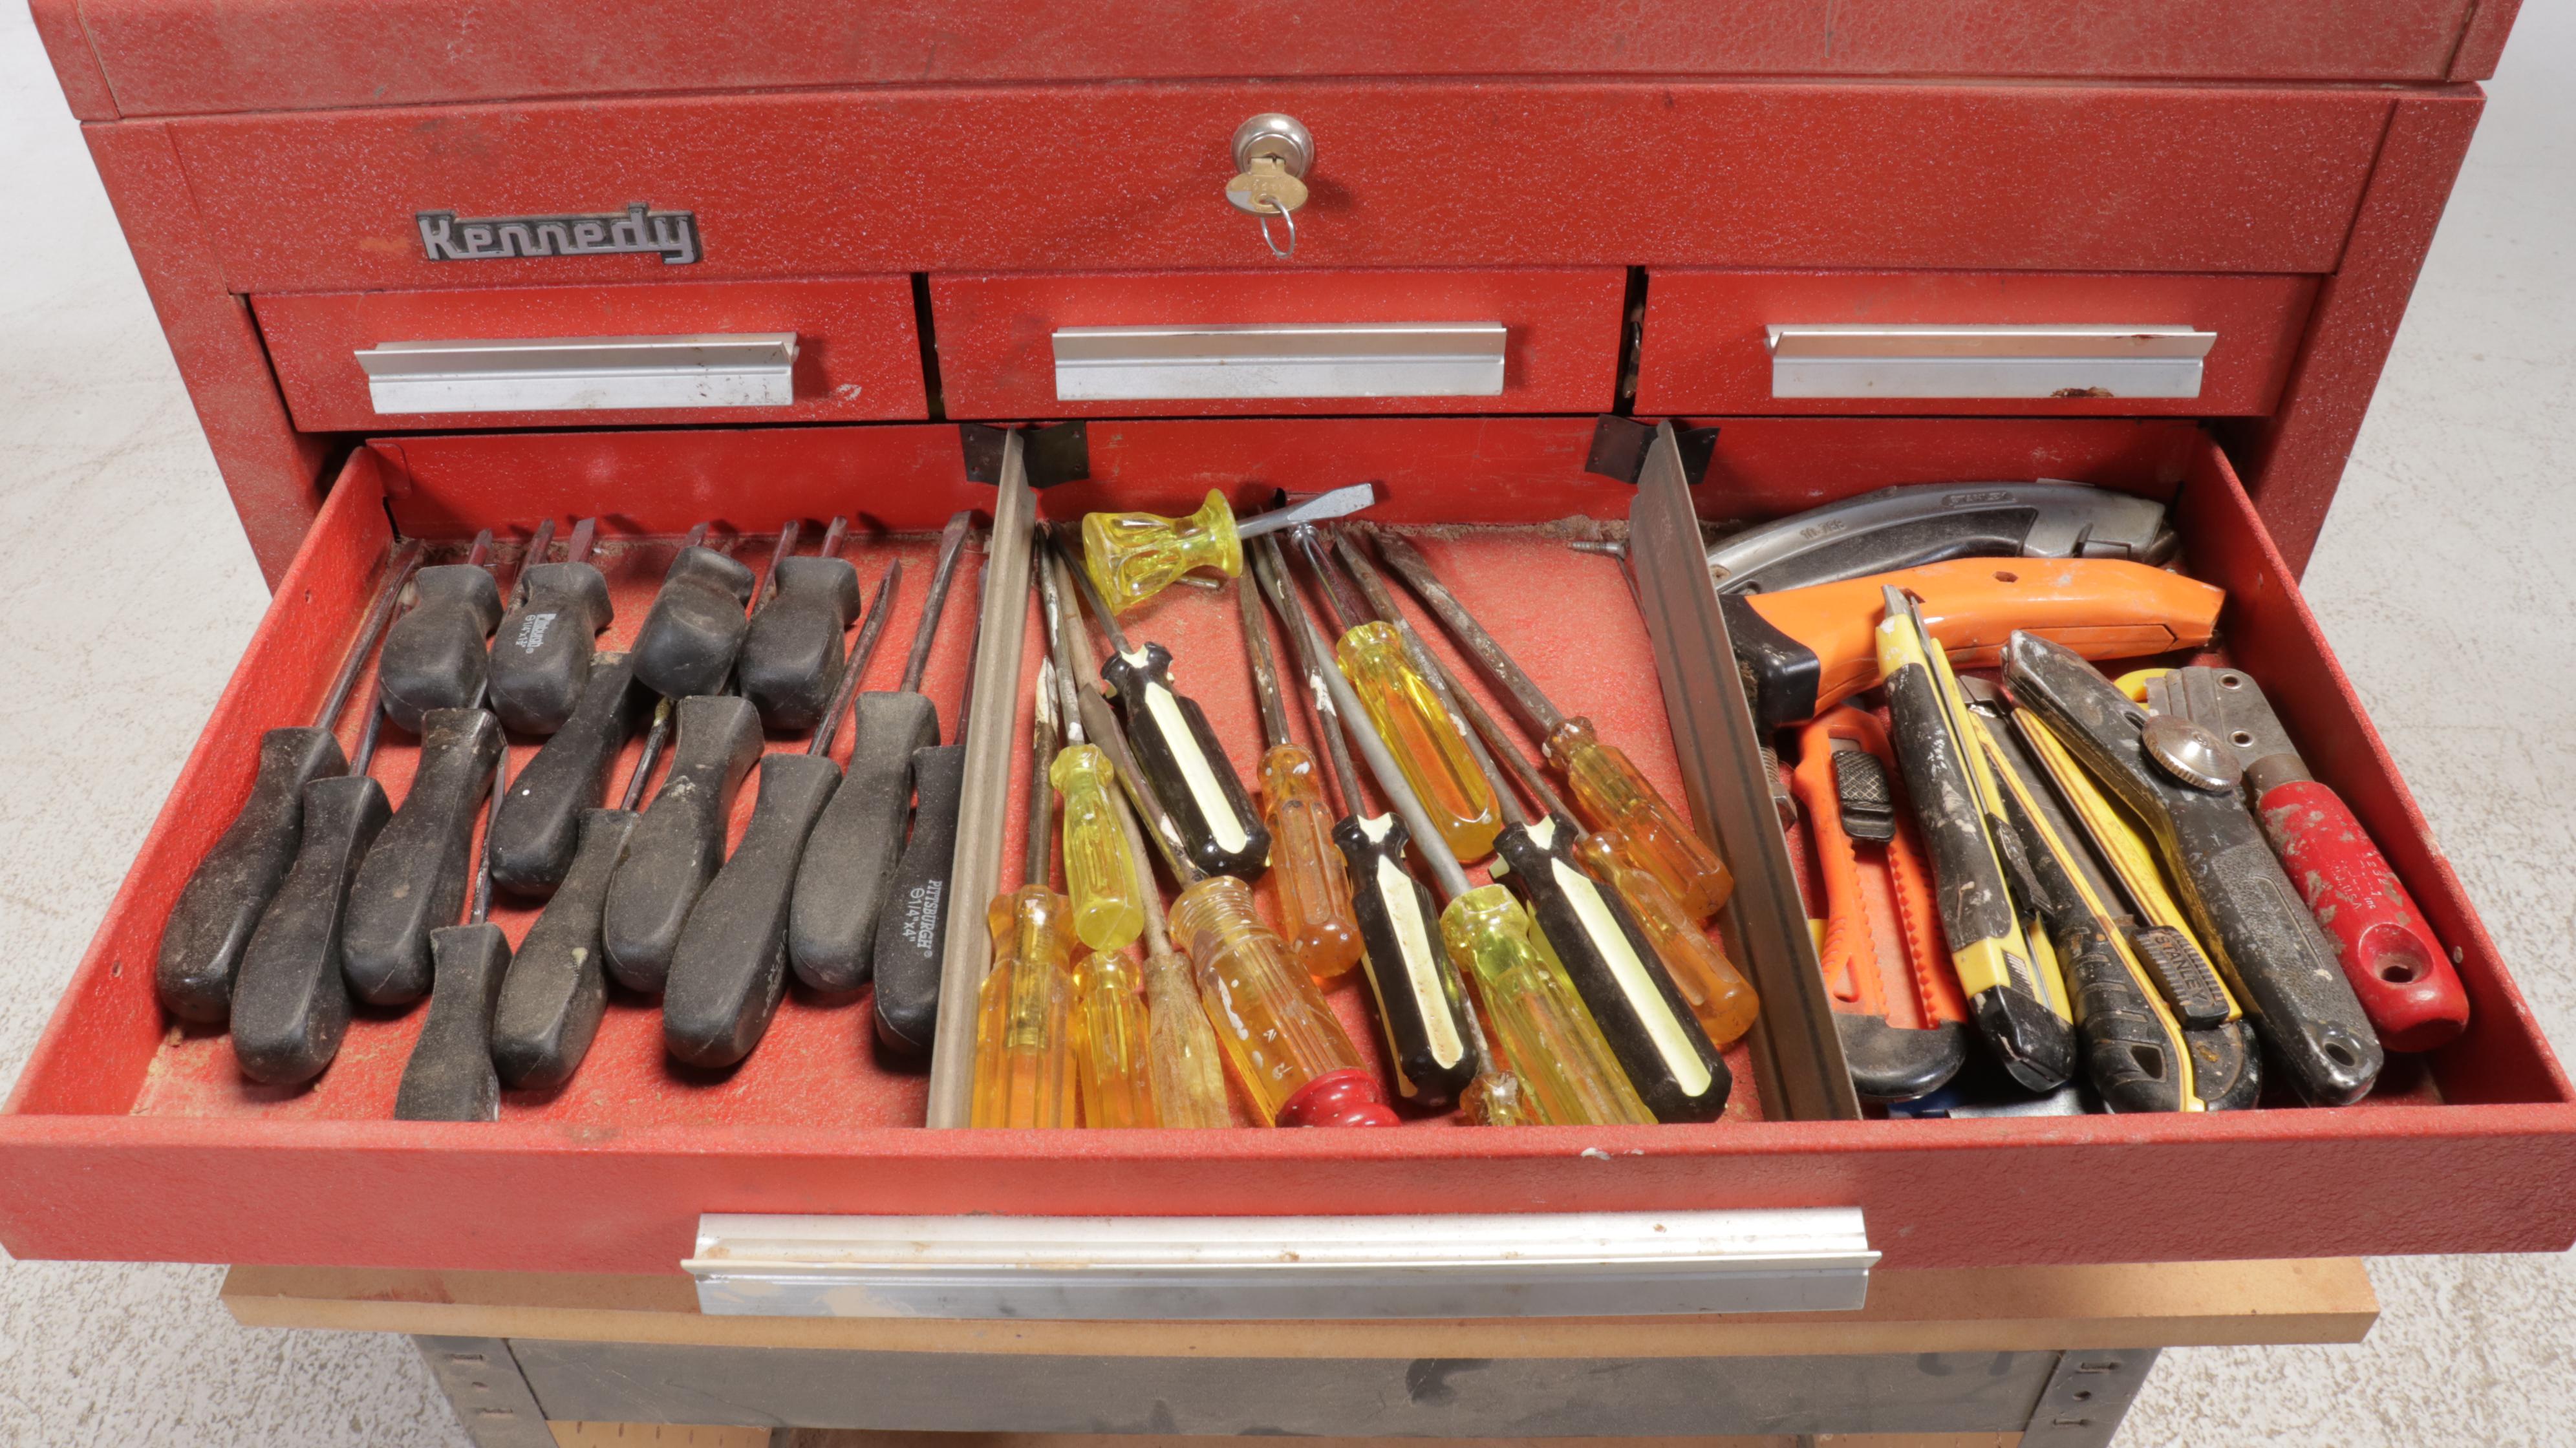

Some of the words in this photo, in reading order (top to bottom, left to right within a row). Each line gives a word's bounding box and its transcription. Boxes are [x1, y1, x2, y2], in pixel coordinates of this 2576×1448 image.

[417, 203, 700, 265] Kennedy
[917, 879, 943, 950] PITTSBURGH
[2154, 935, 2209, 1001] STANLEY
